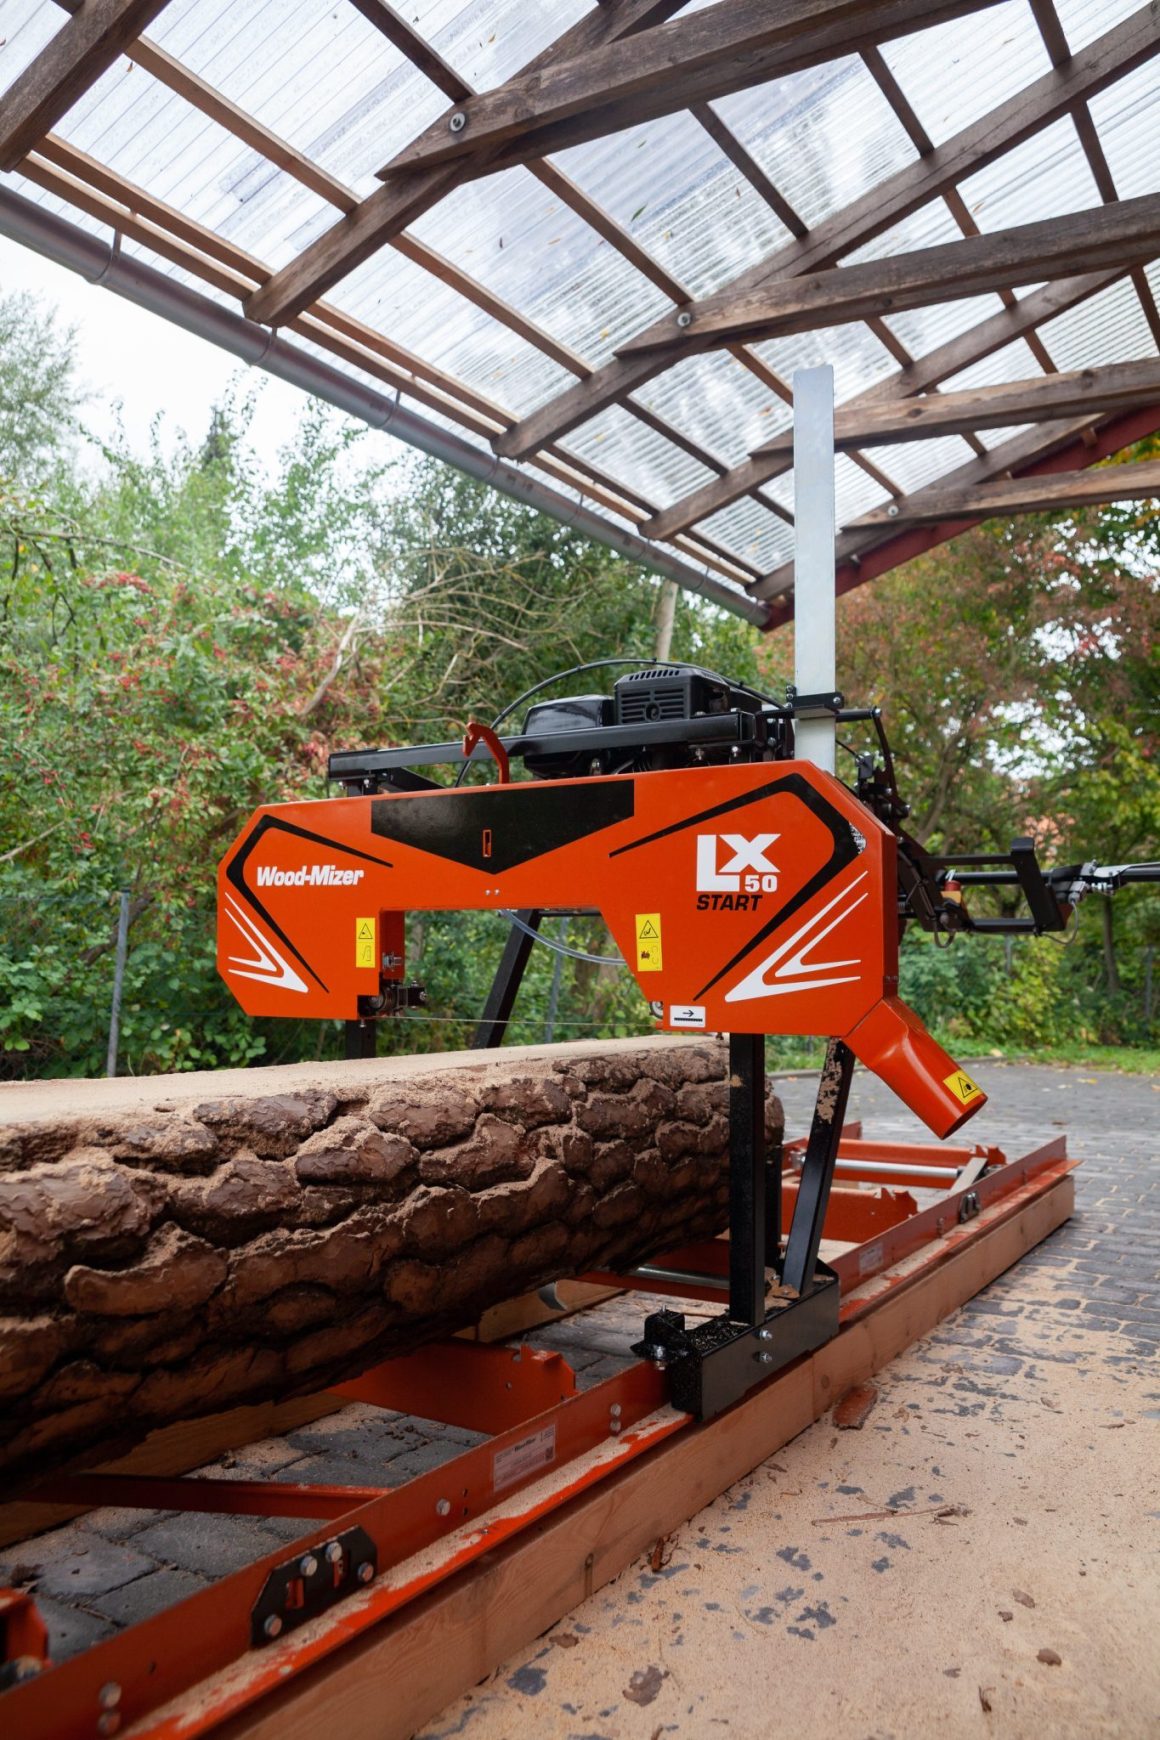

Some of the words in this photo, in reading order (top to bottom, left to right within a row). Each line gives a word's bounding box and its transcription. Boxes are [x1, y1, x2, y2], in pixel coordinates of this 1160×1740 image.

[696, 833, 781, 892] LX
[257, 865, 364, 886] Wood-Mizer
[744, 874, 778, 892] 50
[696, 894, 763, 911] START
